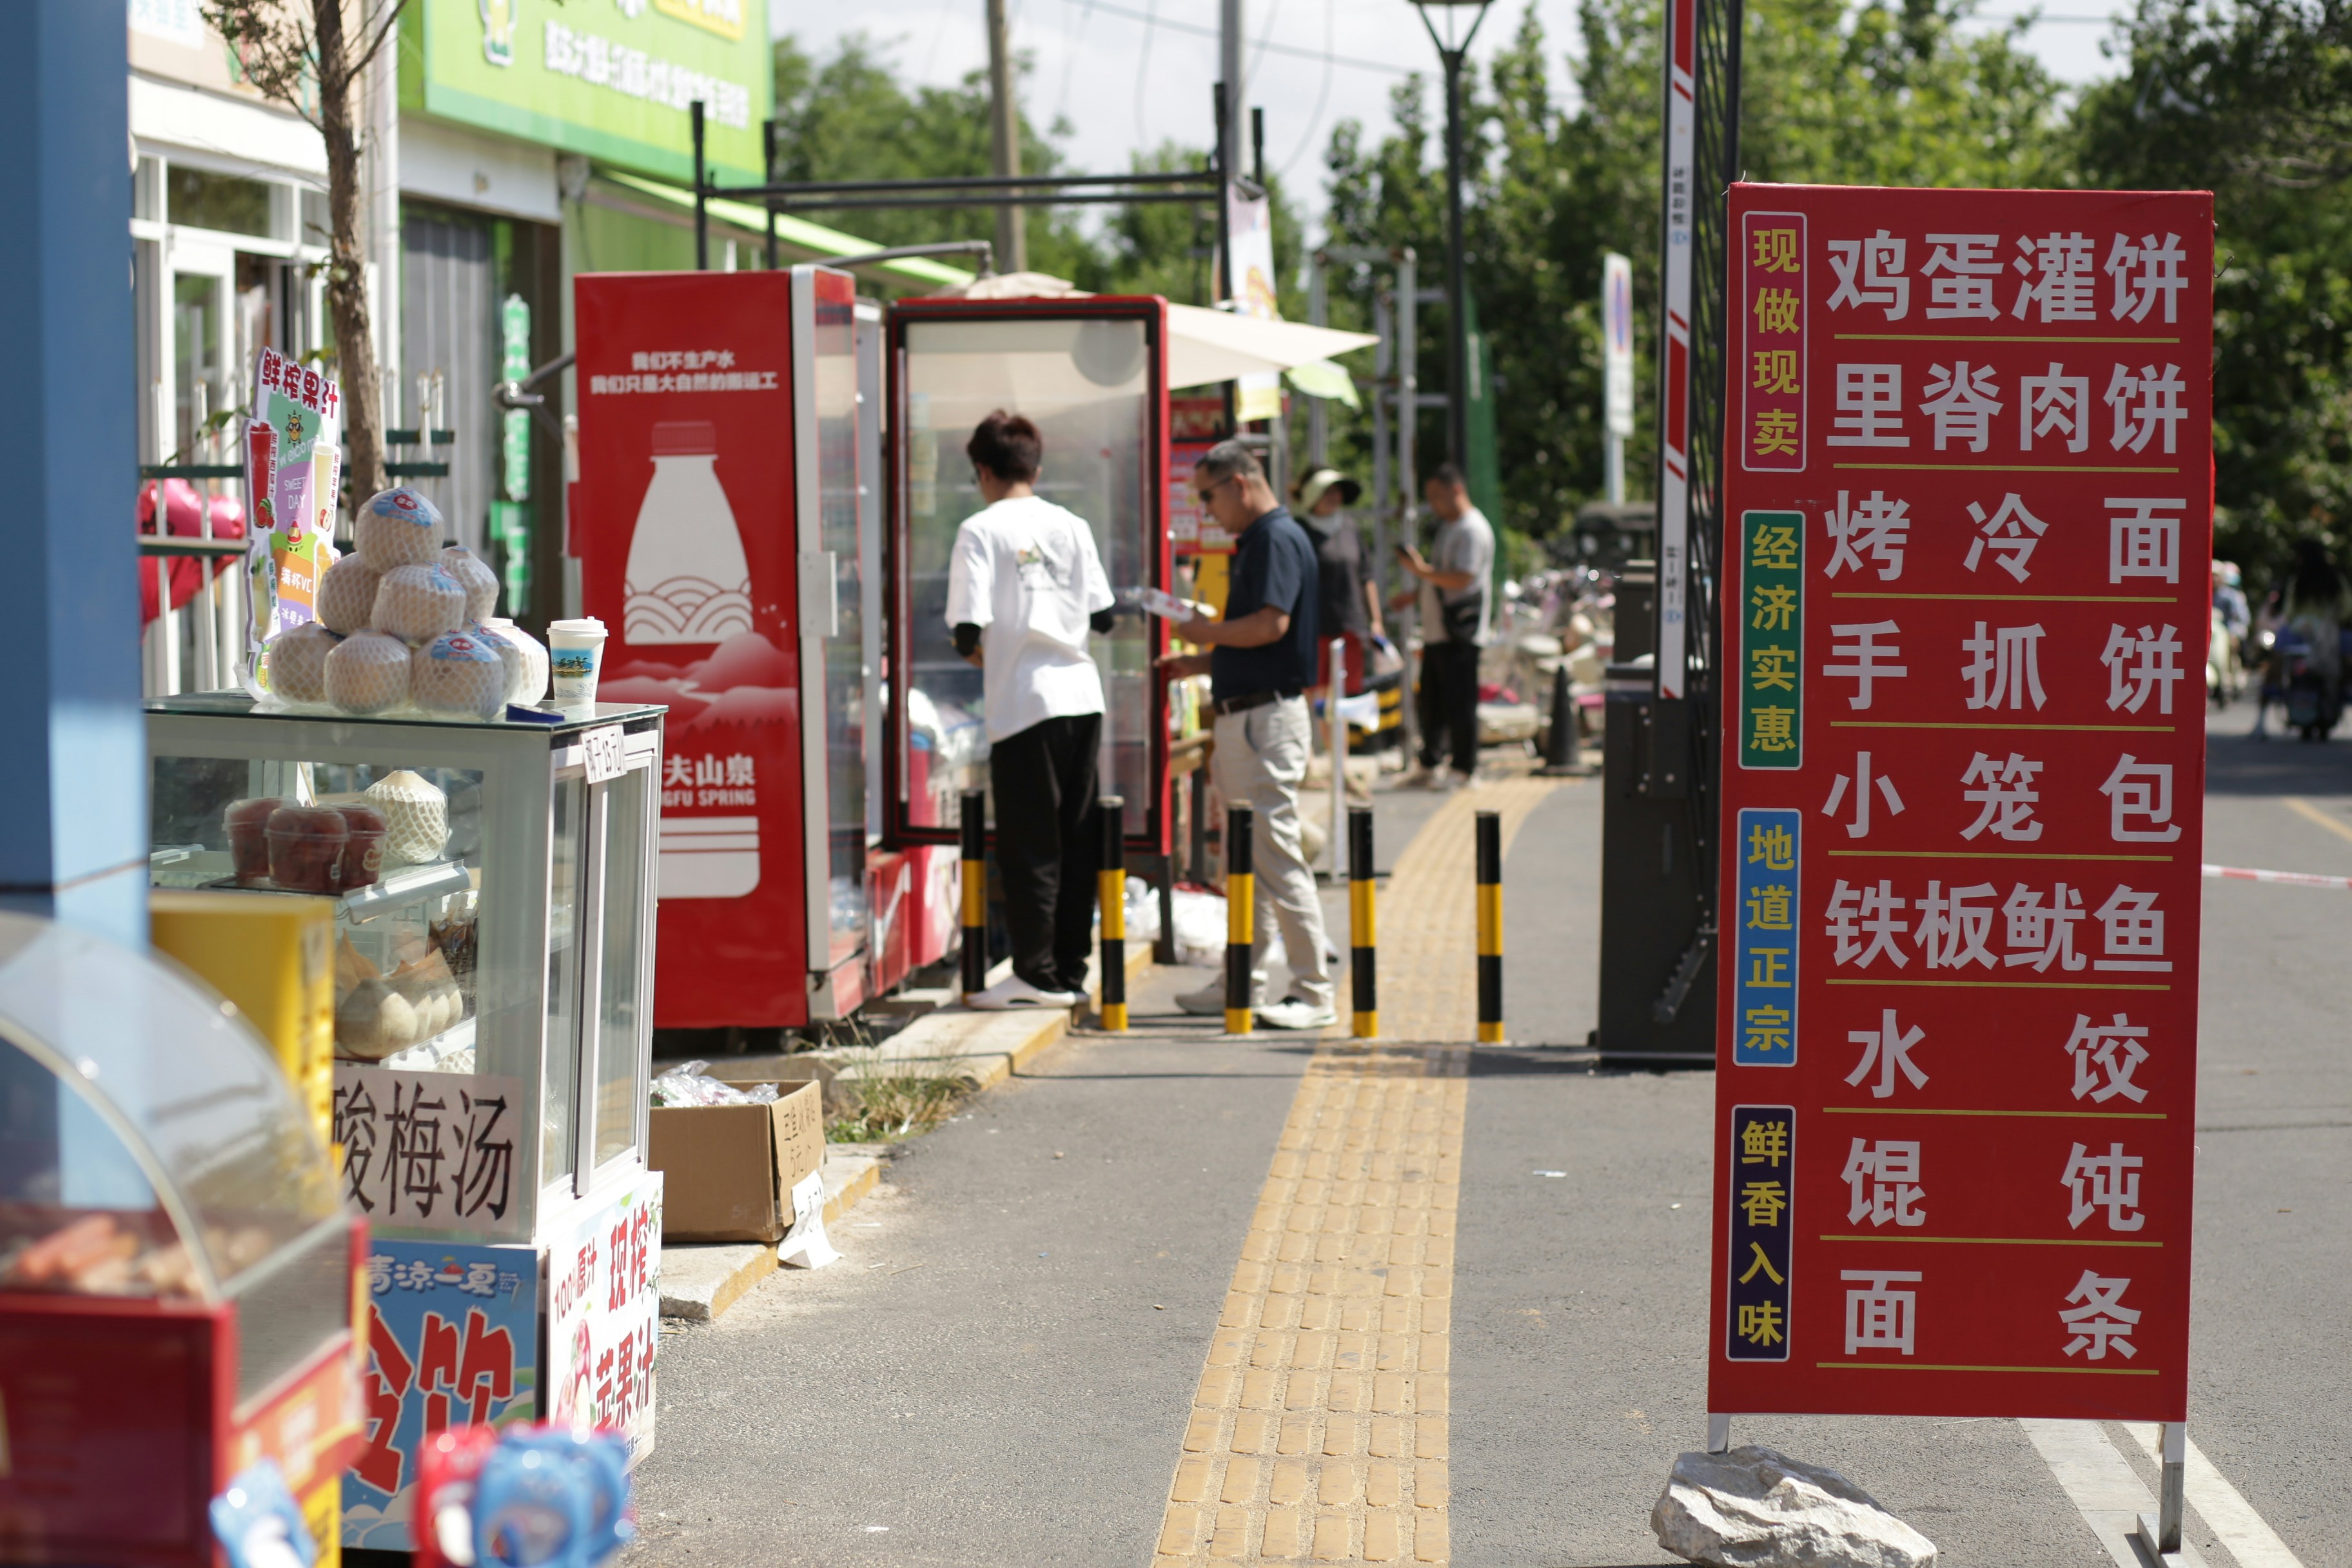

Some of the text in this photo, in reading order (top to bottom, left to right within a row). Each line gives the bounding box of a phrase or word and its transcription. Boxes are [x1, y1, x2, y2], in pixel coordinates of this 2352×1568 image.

[1827, 230, 2188, 323] 鸡蛋灌饼
[262, 349, 338, 419] 鲜榨果汁
[632, 350, 735, 371] 我们不生产水
[1753, 228, 1801, 456] 现做现卖
[1827, 361, 2188, 454] 里脊肉饼
[284, 476, 306, 491] SWEET
[288, 494, 306, 509] DAY
[1824, 490, 2186, 583] 烤冷面
[1750, 524, 1799, 752] 经济实惠
[1823, 620, 2185, 714] 手抓饼
[663, 753, 756, 787] 夫山泉
[698, 789, 756, 807] SPRING
[1821, 751, 2182, 843] 小笼包
[1745, 825, 1794, 1052] 地道正宗
[1825, 879, 2173, 974] 铁板鱿鱼
[1844, 1008, 2150, 1104] 水饺
[333, 1079, 513, 1221] 酸梅汤
[1840, 1137, 2146, 1231] 馄饨
[609, 1200, 648, 1313] 现榨
[1738, 1121, 1788, 1346] 鲜香入味
[1841, 1269, 2142, 1360] 面条
[594, 1317, 654, 1433] 苹果汁
